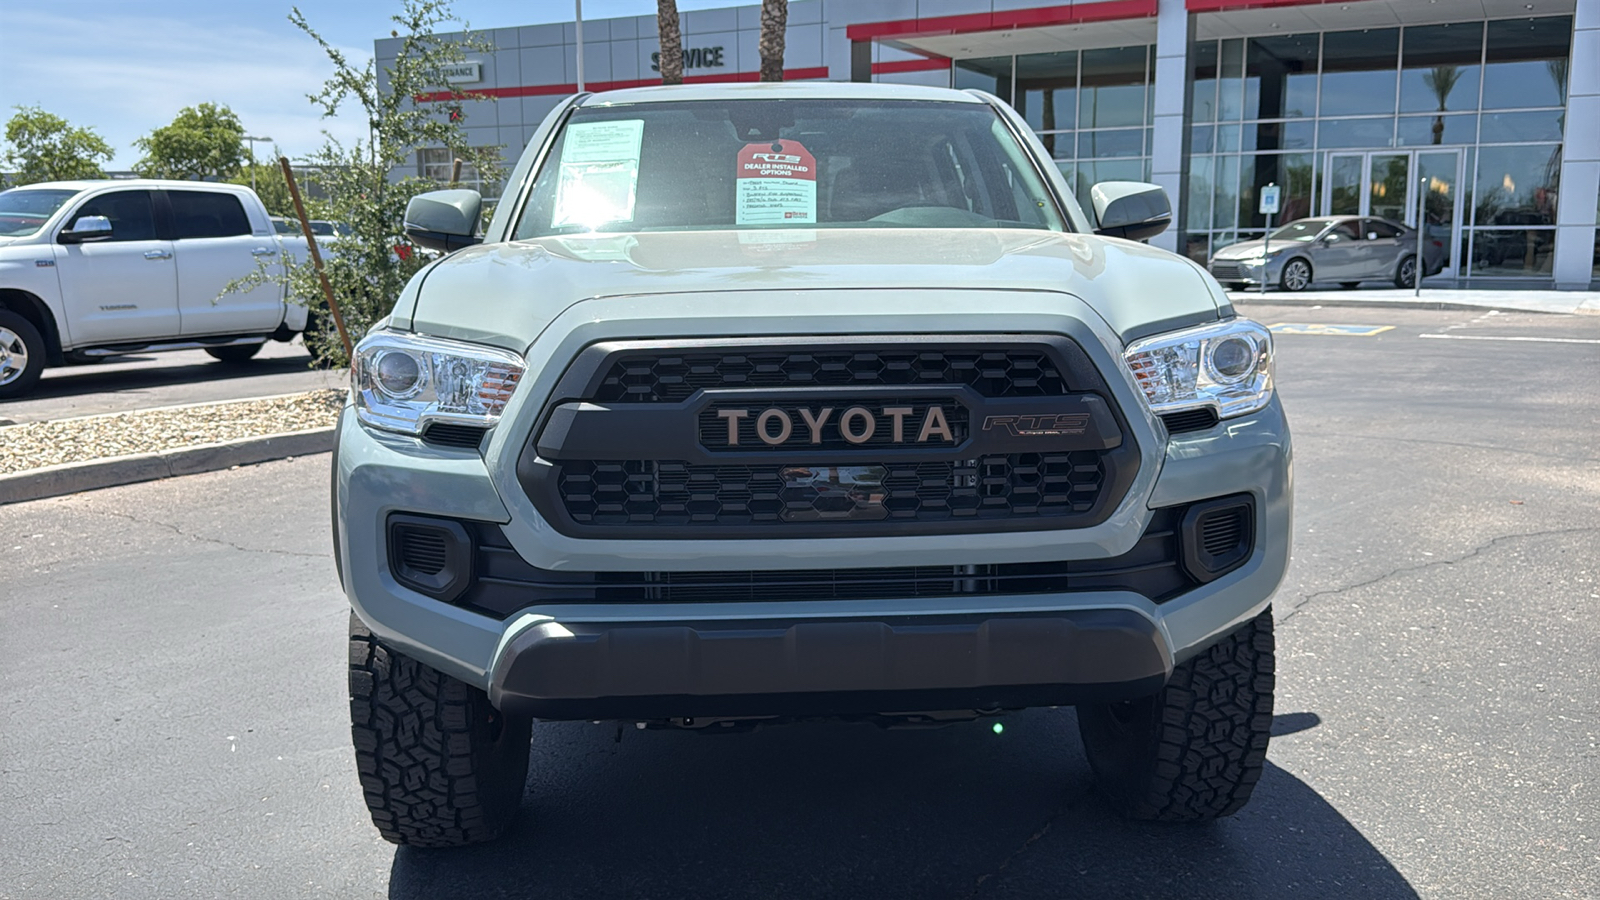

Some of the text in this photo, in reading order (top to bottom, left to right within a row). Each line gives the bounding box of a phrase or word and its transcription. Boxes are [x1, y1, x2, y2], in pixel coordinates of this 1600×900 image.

[651, 46, 724, 72] SVICE
[752, 153, 801, 164] RTS
[772, 164, 808, 172] INSTALLED
[717, 406, 954, 445] TOYOTA
[982, 413, 1090, 436] RTS
